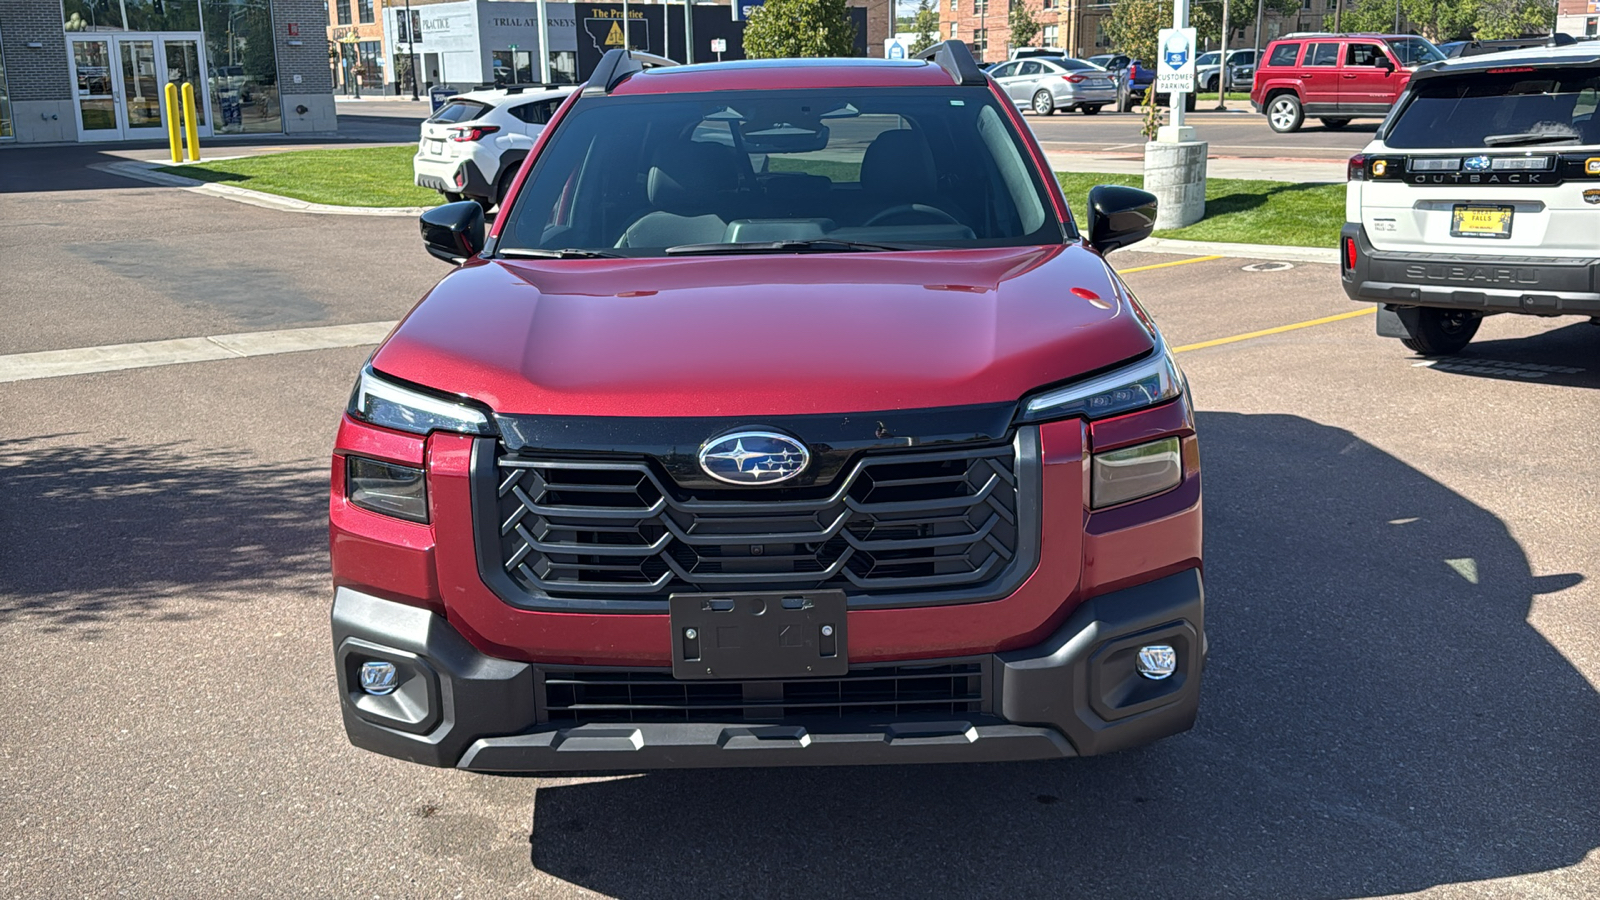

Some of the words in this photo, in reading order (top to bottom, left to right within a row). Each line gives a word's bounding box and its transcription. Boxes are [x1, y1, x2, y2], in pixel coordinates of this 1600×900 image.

[592, 8, 609, 18] The
[611, 9, 643, 18] Pratice
[422, 18, 450, 30] PRACTICE
[493, 18, 522, 27] TRIAL
[524, 18, 576, 27] ATRNEYS
[1158, 73, 1194, 81] CUSTOMER
[1415, 174, 1540, 183] OUTBACK
[1406, 265, 1540, 284] SUBARU
